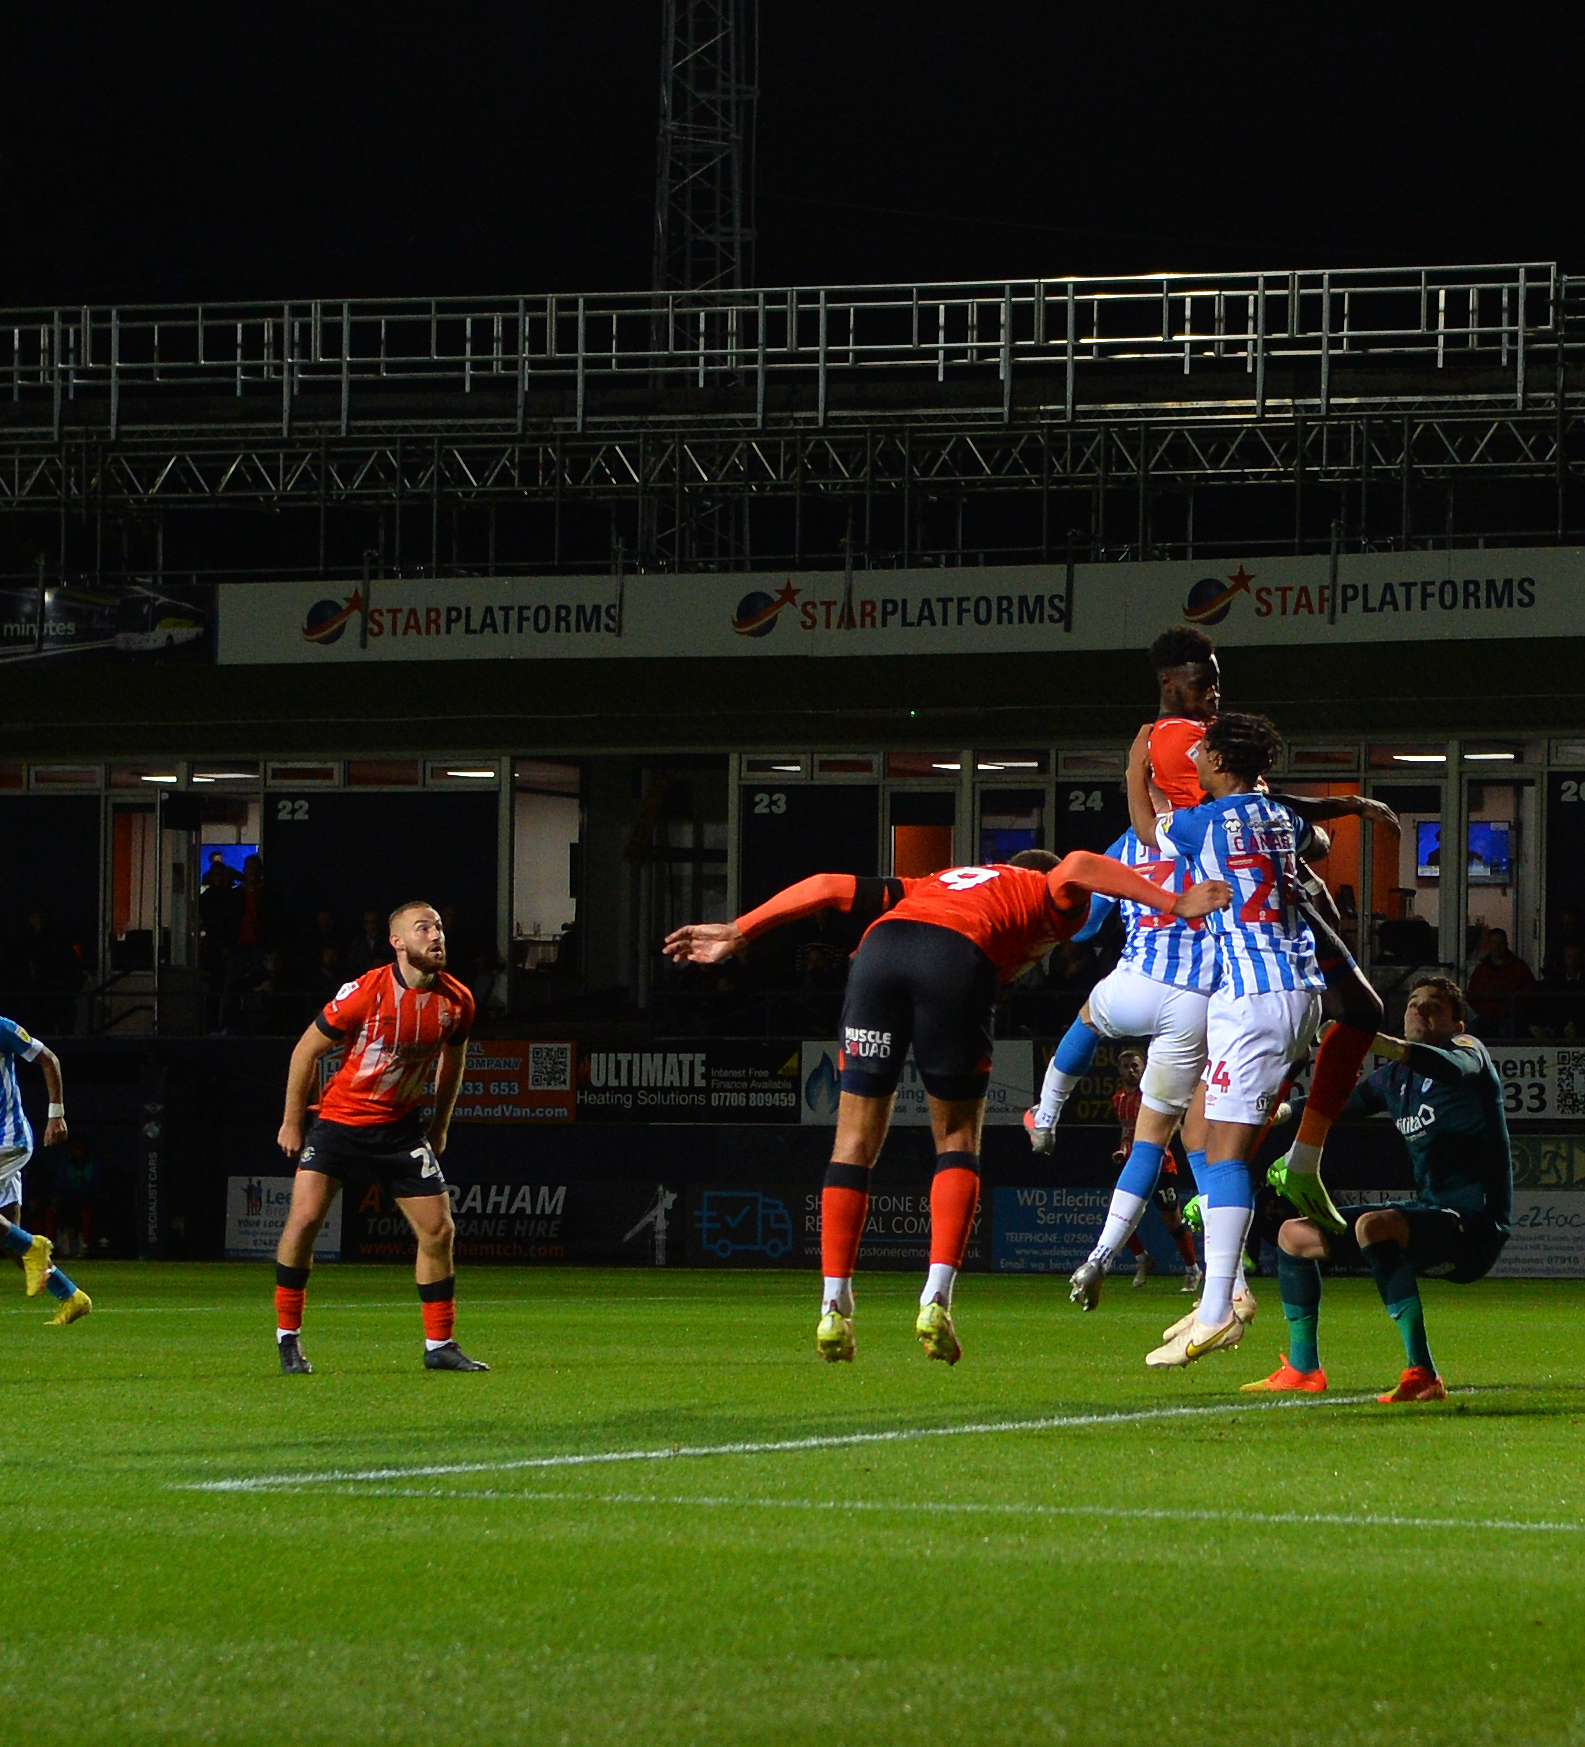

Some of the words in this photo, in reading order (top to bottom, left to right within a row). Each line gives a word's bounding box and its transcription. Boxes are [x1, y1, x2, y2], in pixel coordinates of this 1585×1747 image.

[1254, 577, 1535, 618] STARPLATFORMS
[367, 604, 619, 637] STARPLATFORMS
[801, 594, 1066, 631] STARPLATFORMS
[3, 617, 76, 637] mintes
[277, 799, 310, 821] 22
[753, 792, 788, 815] 23
[1068, 790, 1104, 812] 24
[589, 1052, 708, 1087] ULTIMATE
[711, 1066, 747, 1079] Interest
[748, 1066, 770, 1078] Free
[488, 1081, 520, 1096] 653
[711, 1078, 748, 1090] Finance
[576, 1090, 634, 1109] Heating
[637, 1089, 708, 1106] Solutions
[711, 1092, 748, 1108] 07706
[748, 1092, 797, 1108] 809459
[148, 1151, 158, 1181] CARS
[1016, 1189, 1047, 1206] WD
[1158, 1186, 1177, 1205] 18
[148, 1182, 158, 1243] SPECIALIST
[1036, 1207, 1104, 1226] Services
[513, 1218, 563, 1240] HIRE
